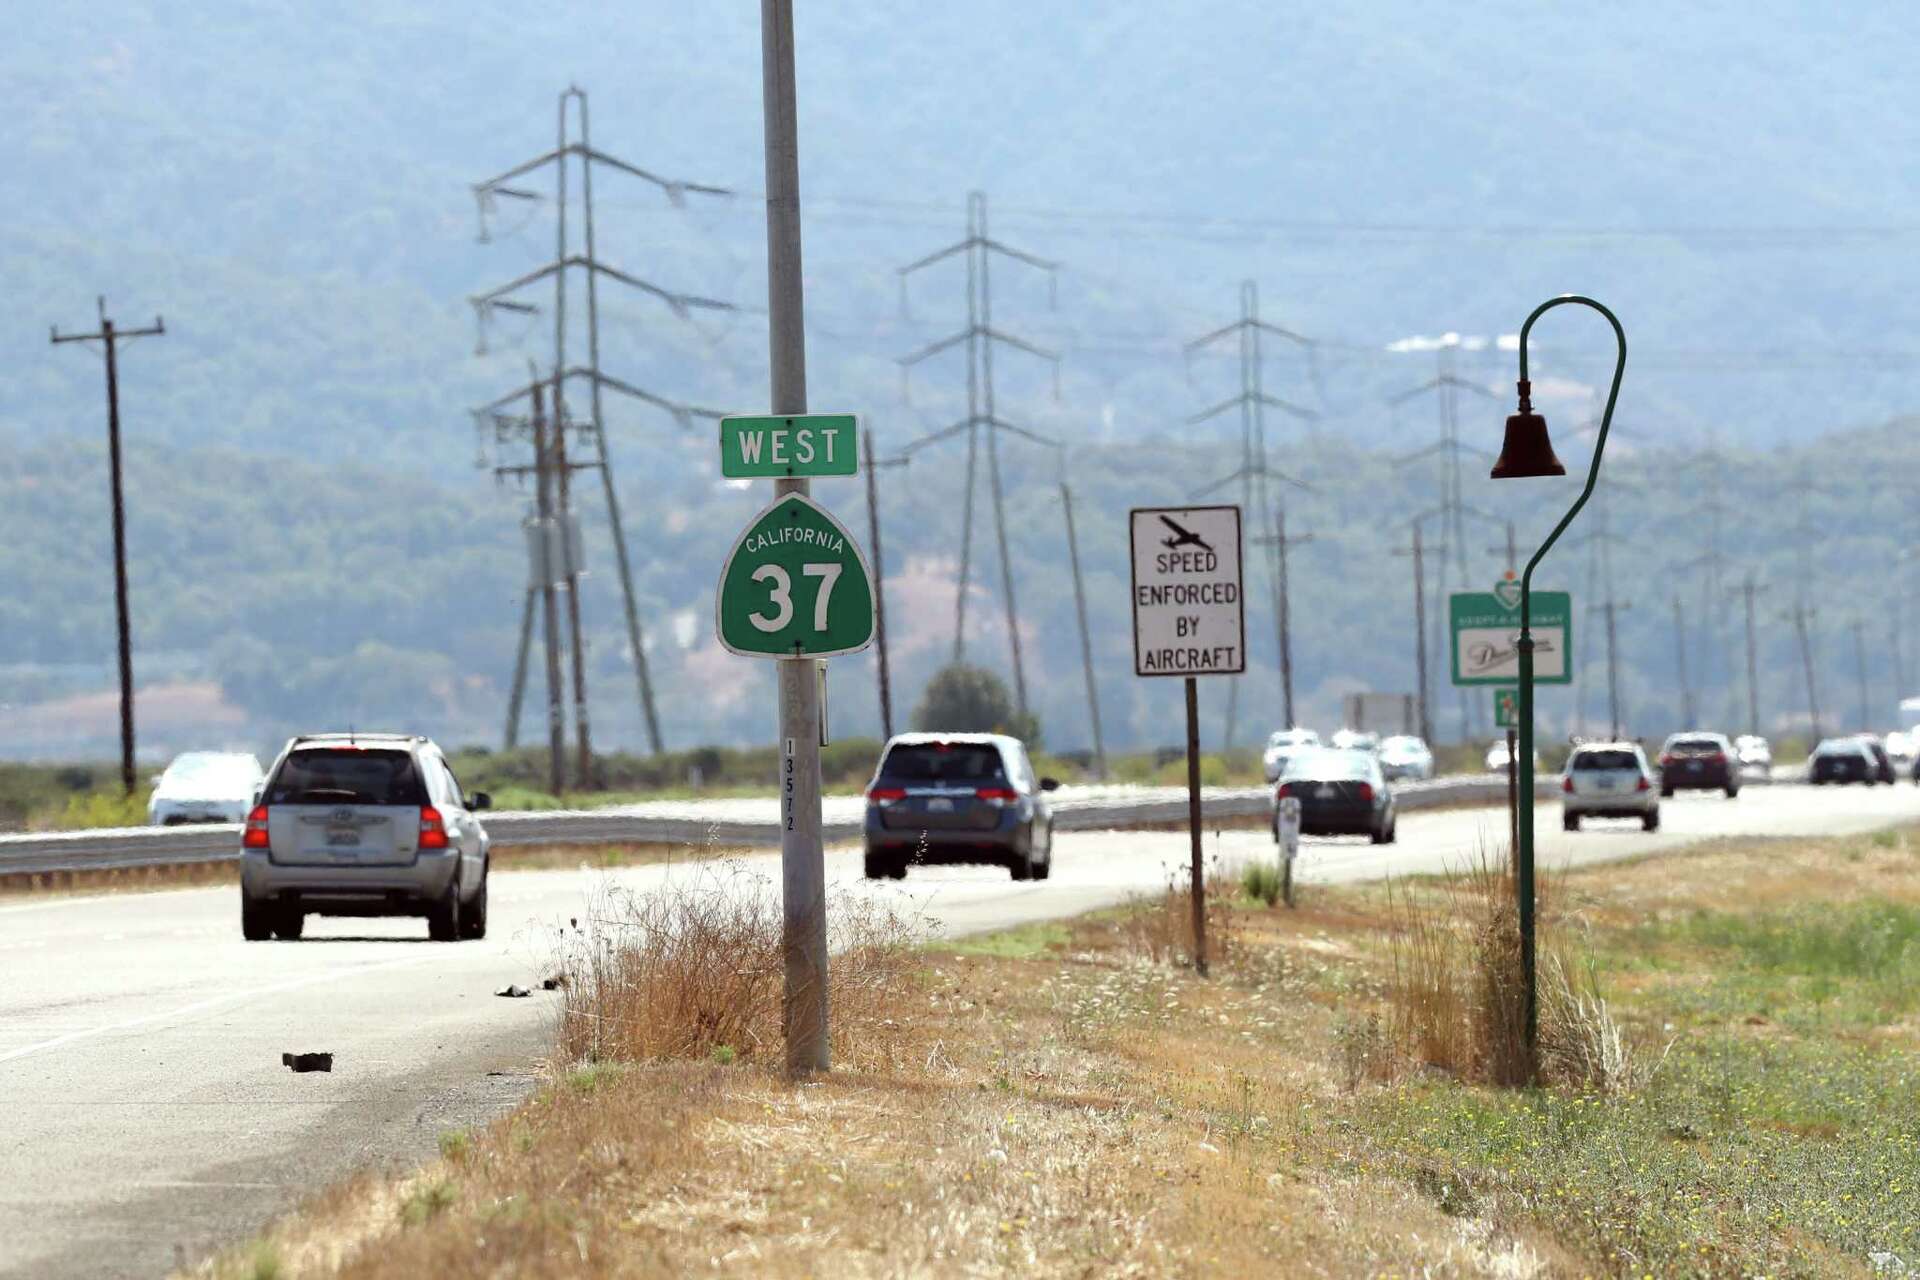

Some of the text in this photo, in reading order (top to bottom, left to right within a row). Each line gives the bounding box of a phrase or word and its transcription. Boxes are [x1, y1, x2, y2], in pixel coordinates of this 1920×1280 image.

[738, 429, 838, 465] WEST
[746, 527, 844, 554] CALIFORNIA
[1156, 552, 1217, 574] SPEED
[748, 563, 843, 633] 37
[1138, 583, 1237, 606] ENFORCED
[1176, 616, 1200, 637] BY
[1144, 647, 1236, 669] AIRCRAFT
[786, 739, 794, 831] 13572
